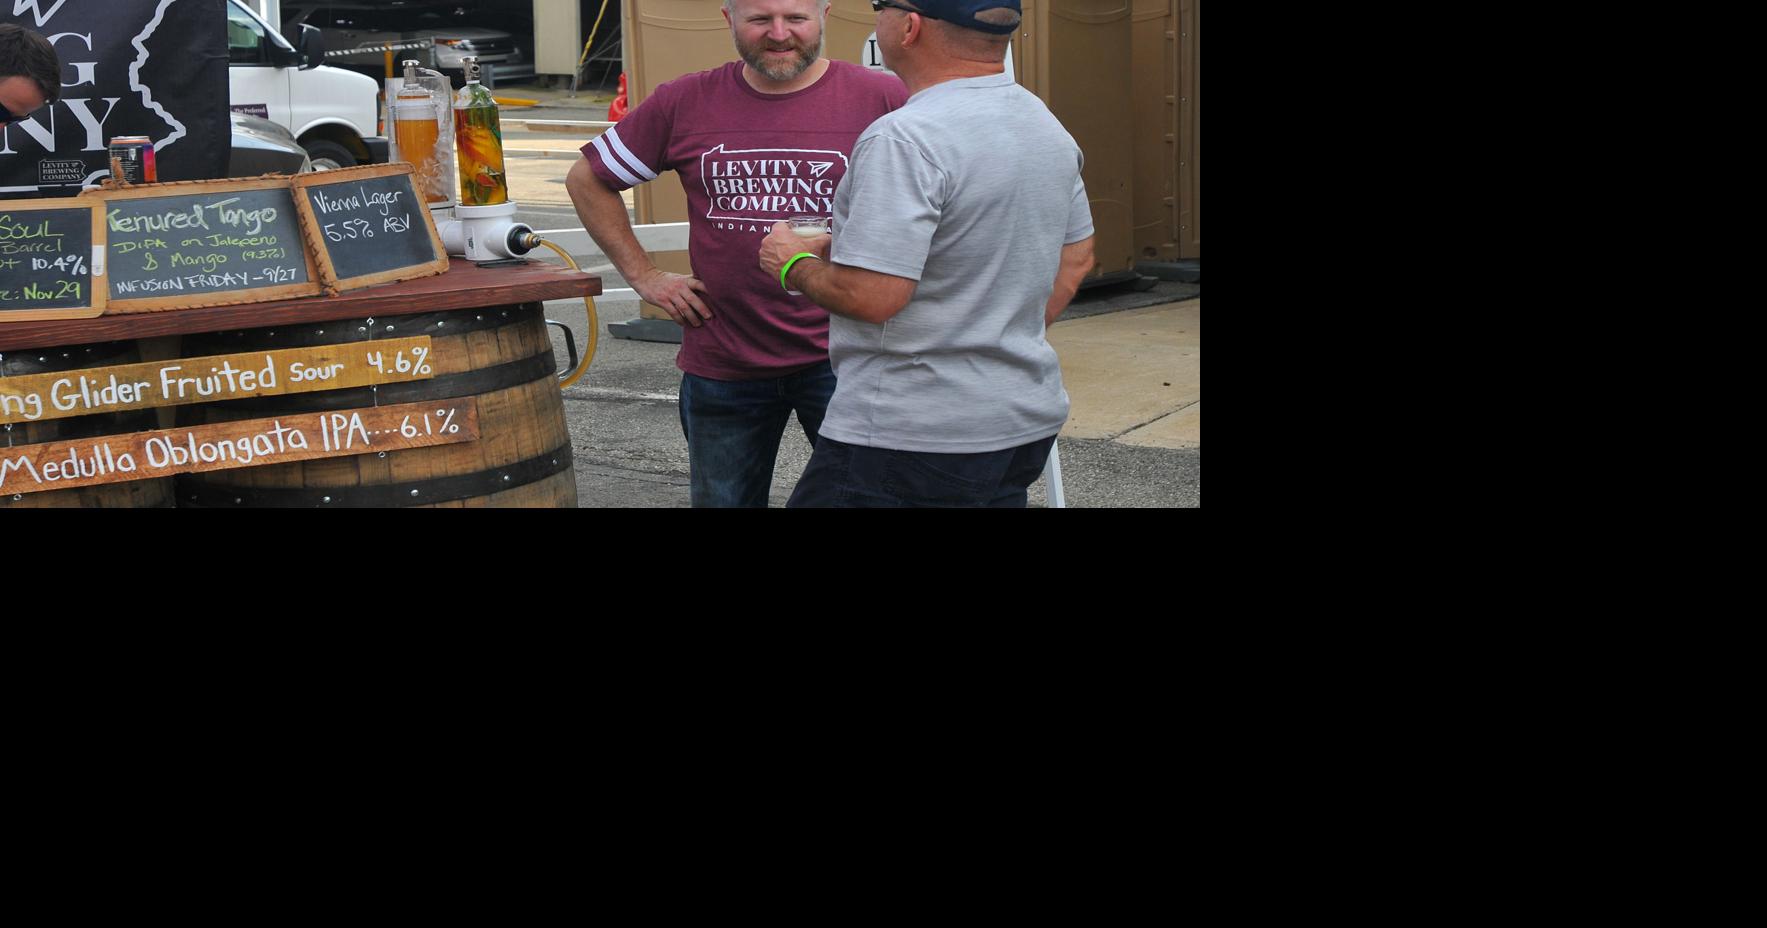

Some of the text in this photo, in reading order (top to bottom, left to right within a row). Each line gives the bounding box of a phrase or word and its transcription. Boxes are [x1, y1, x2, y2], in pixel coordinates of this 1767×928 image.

[711, 159, 802, 178] LEVITY
[712, 177, 833, 196] BREWING
[314, 186, 403, 216] Vienna Lager
[716, 195, 833, 213] COMPANY
[107, 197, 277, 236] Tenured Tango
[324, 213, 410, 242] 5.5% ABV
[0, 239, 62, 255] Barrel
[181, 239, 204, 247] on
[205, 233, 277, 248] Jalepeno
[31, 254, 88, 276] 10.4%
[141, 252, 159, 271] &
[171, 252, 227, 273] Mango
[116, 277, 184, 294] INFUSION
[184, 272, 248, 288] FRIDAY
[51, 374, 152, 411] Glider
[159, 354, 277, 399] Fruited
[366, 346, 432, 376] 4.6%
[0, 442, 137, 488] Medulla
[145, 419, 308, 469] Oblongata
